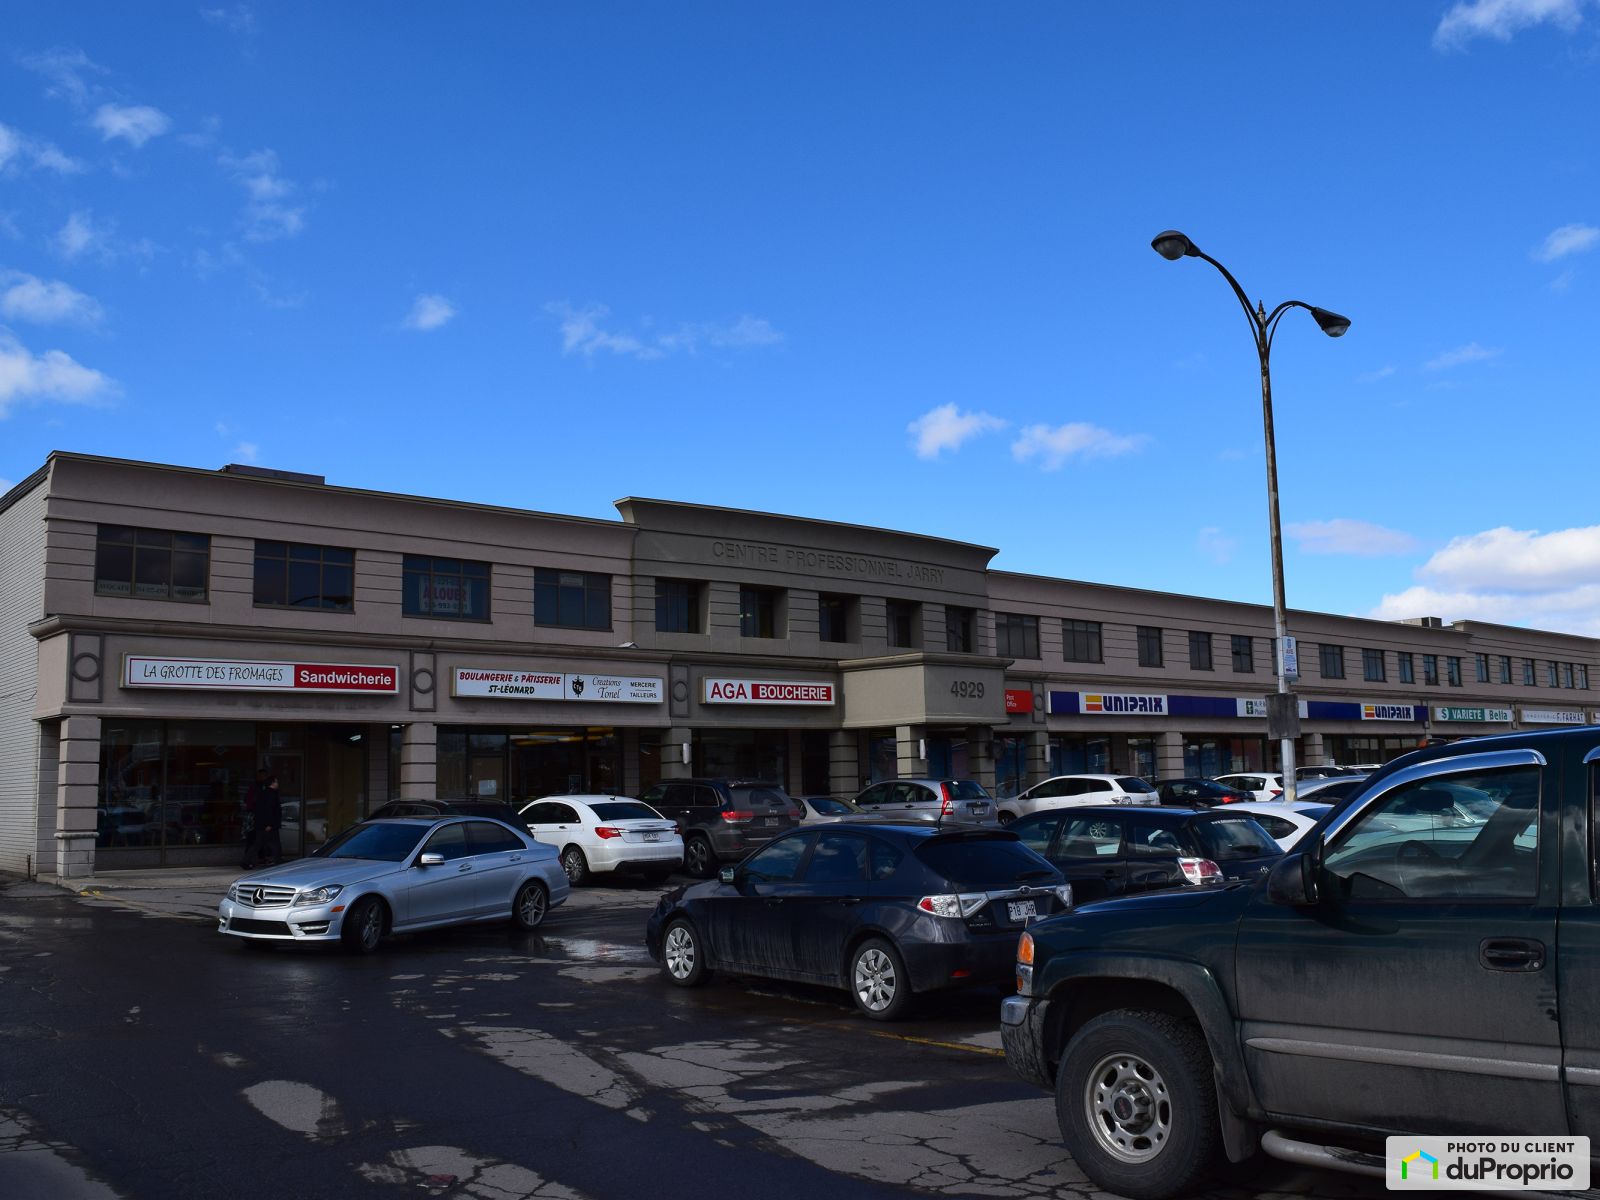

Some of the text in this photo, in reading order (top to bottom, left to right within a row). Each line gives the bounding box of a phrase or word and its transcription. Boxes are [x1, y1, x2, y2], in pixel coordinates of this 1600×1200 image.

[712, 541, 945, 584] CENTRE PROFESSIONNEL JARRY
[143, 664, 392, 686] LA GROTTE DES FROMAGES Sandwicherie
[459, 671, 513, 683] BOULANGERIE
[514, 675, 519, 683] &
[710, 682, 828, 700] AGA BOUCHERIE
[950, 681, 985, 699] 4929
[1102, 695, 1163, 713] UNIPRIX
[1374, 705, 1412, 719] UNIPRIX
